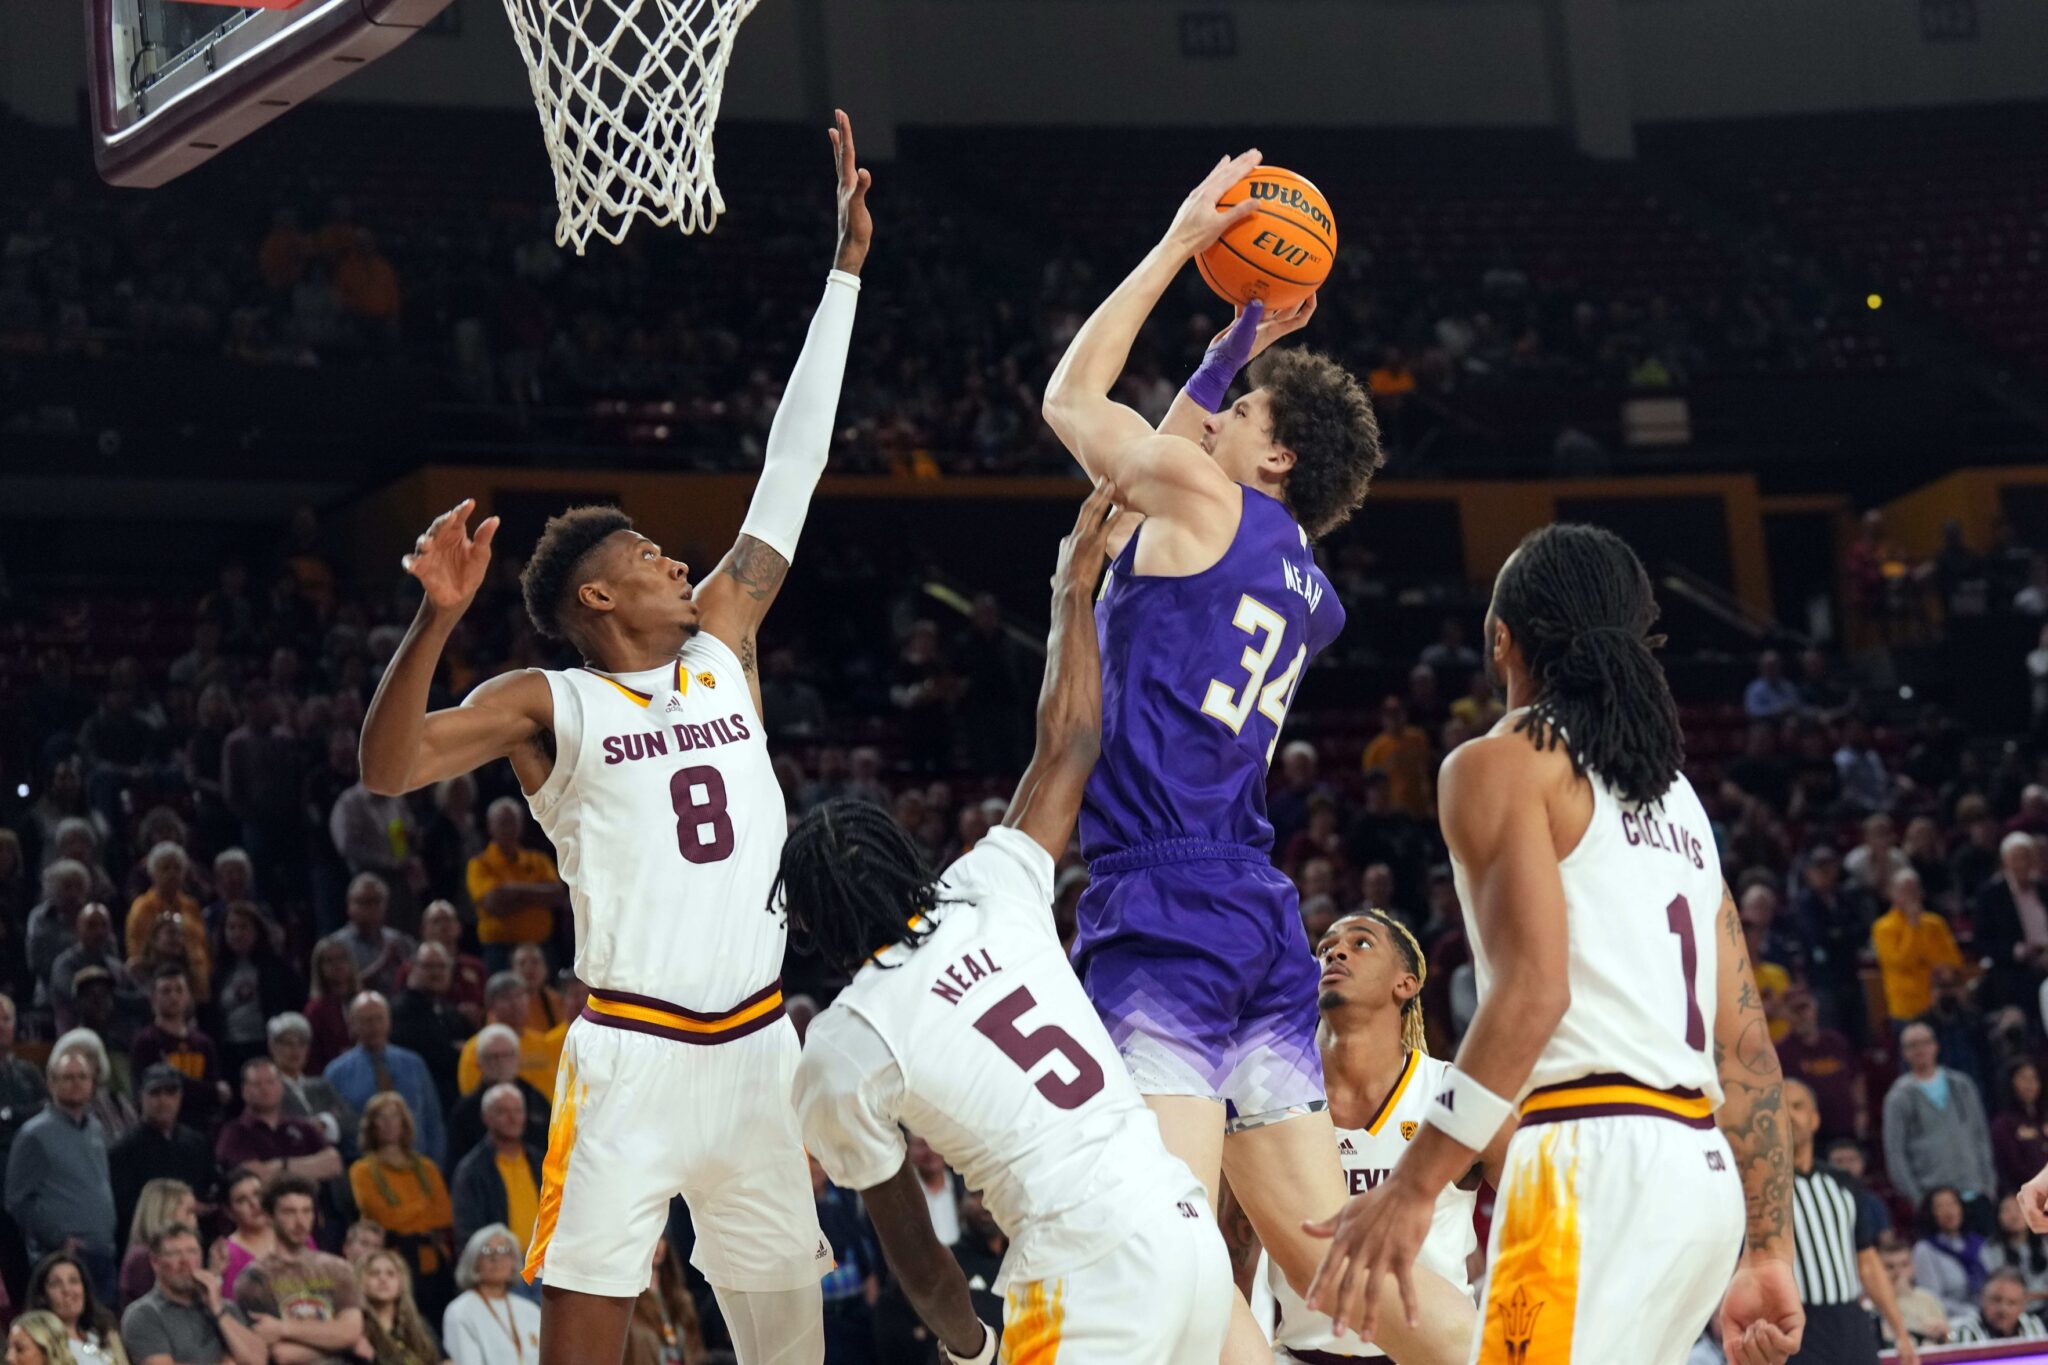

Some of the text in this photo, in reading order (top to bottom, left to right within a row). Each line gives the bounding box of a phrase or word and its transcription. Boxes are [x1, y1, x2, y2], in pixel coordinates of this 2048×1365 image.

[1249, 182, 1331, 236] Wilson
[1252, 230, 1309, 266] EVO
[1282, 557, 1323, 615] MEAH
[1200, 593, 1307, 768] 34
[602, 713, 750, 765] SUN DEVILS
[669, 765, 734, 864] 8
[930, 948, 1002, 1006] NEAL
[1665, 892, 1706, 1053] 1
[972, 984, 1105, 1110] 5
